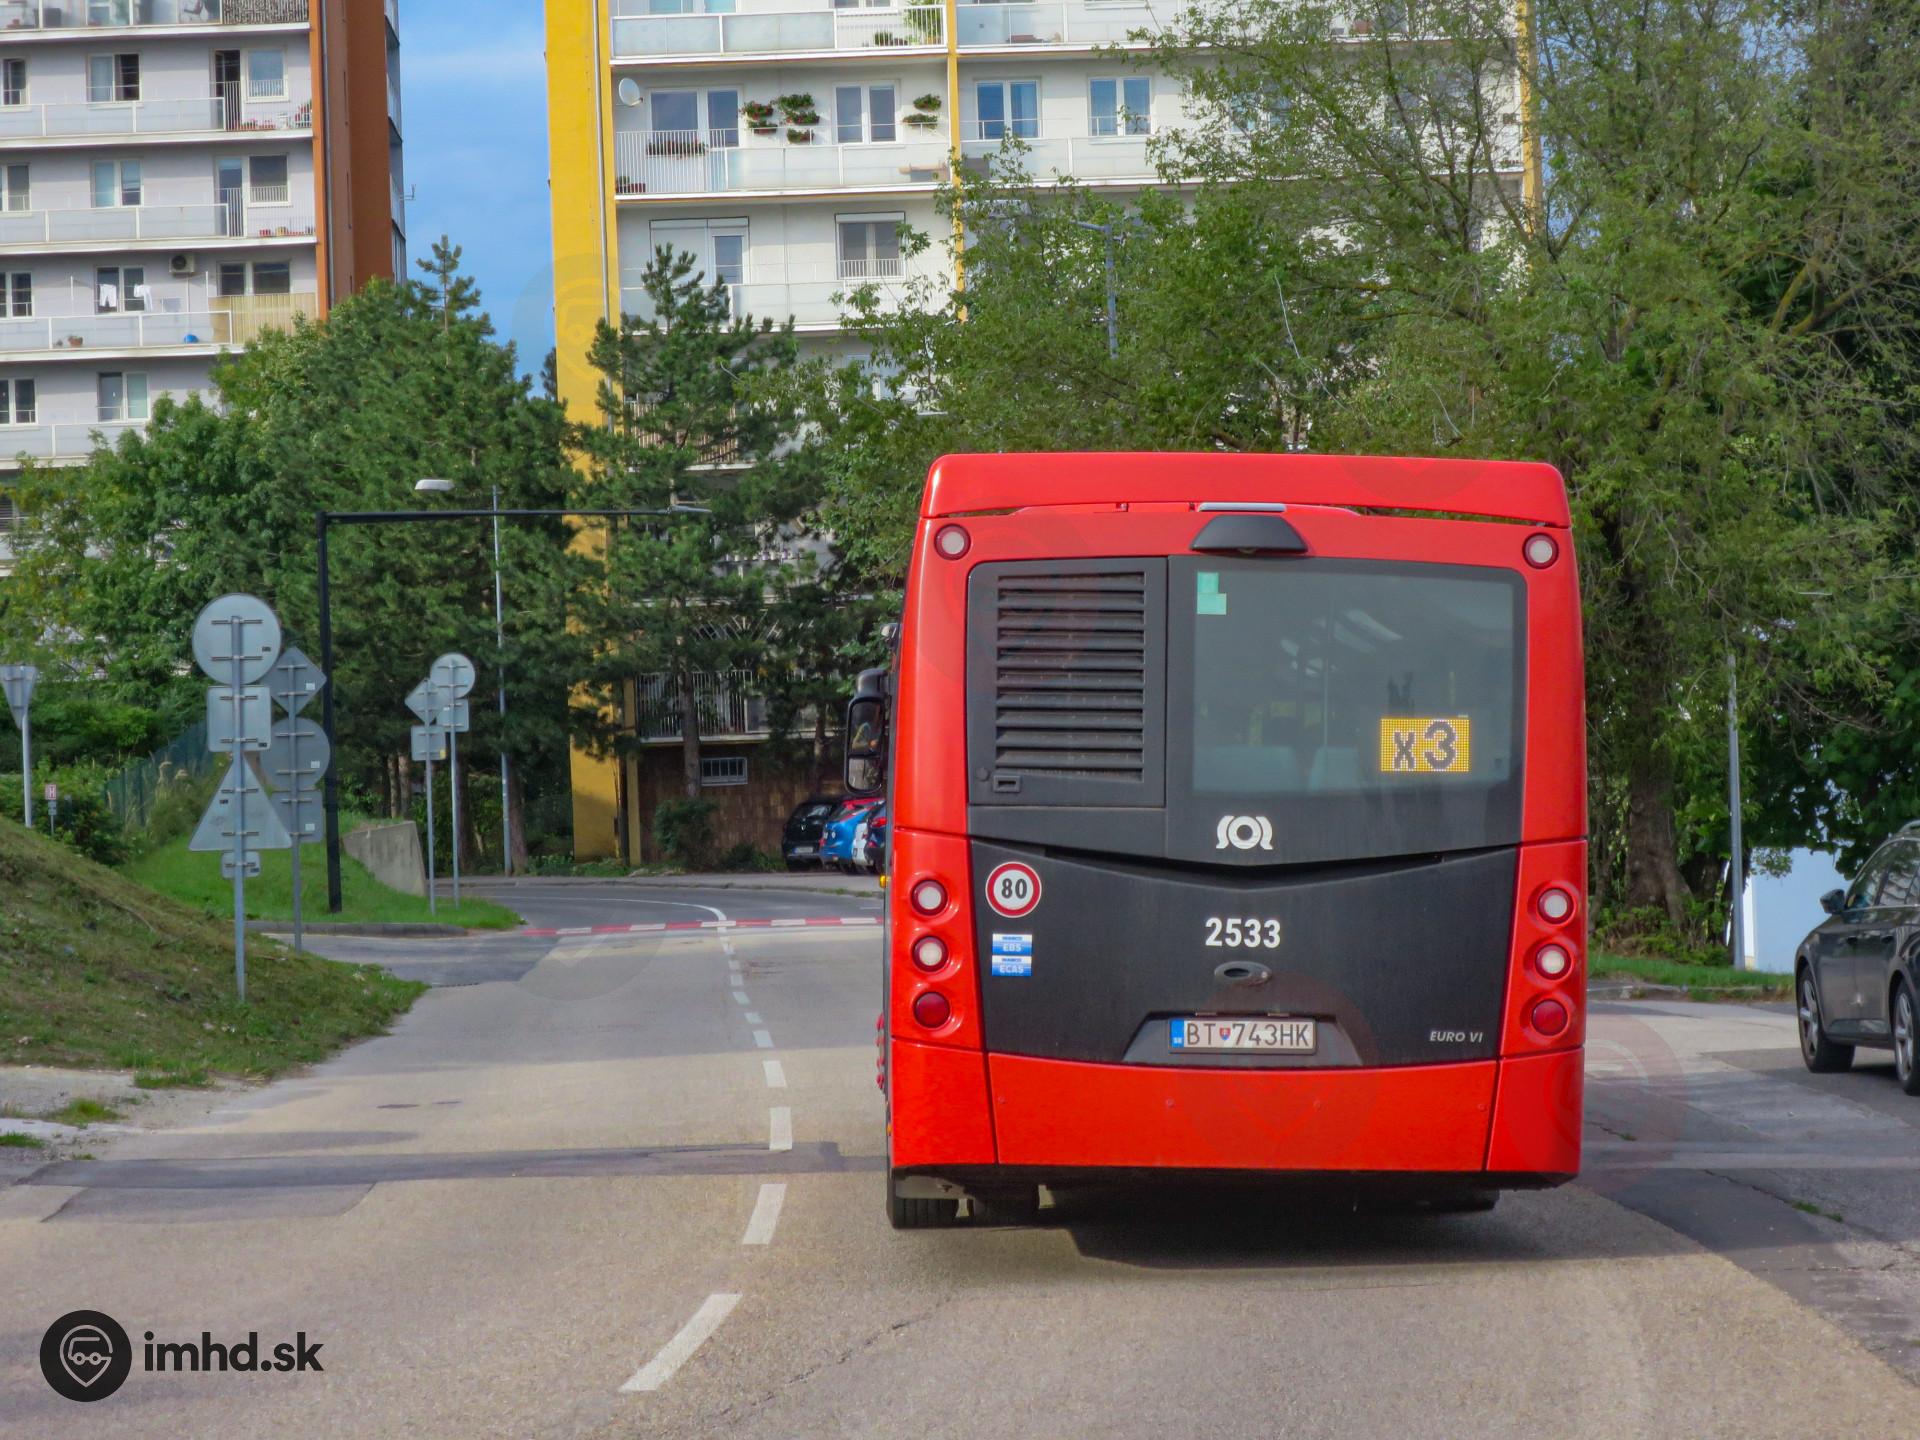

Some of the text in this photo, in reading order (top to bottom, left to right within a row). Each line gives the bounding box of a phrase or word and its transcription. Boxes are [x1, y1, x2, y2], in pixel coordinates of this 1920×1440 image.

[1001, 878, 1028, 899] 80
[1205, 917, 1280, 949] 2533
[1430, 1031, 1483, 1043] EURO VI
